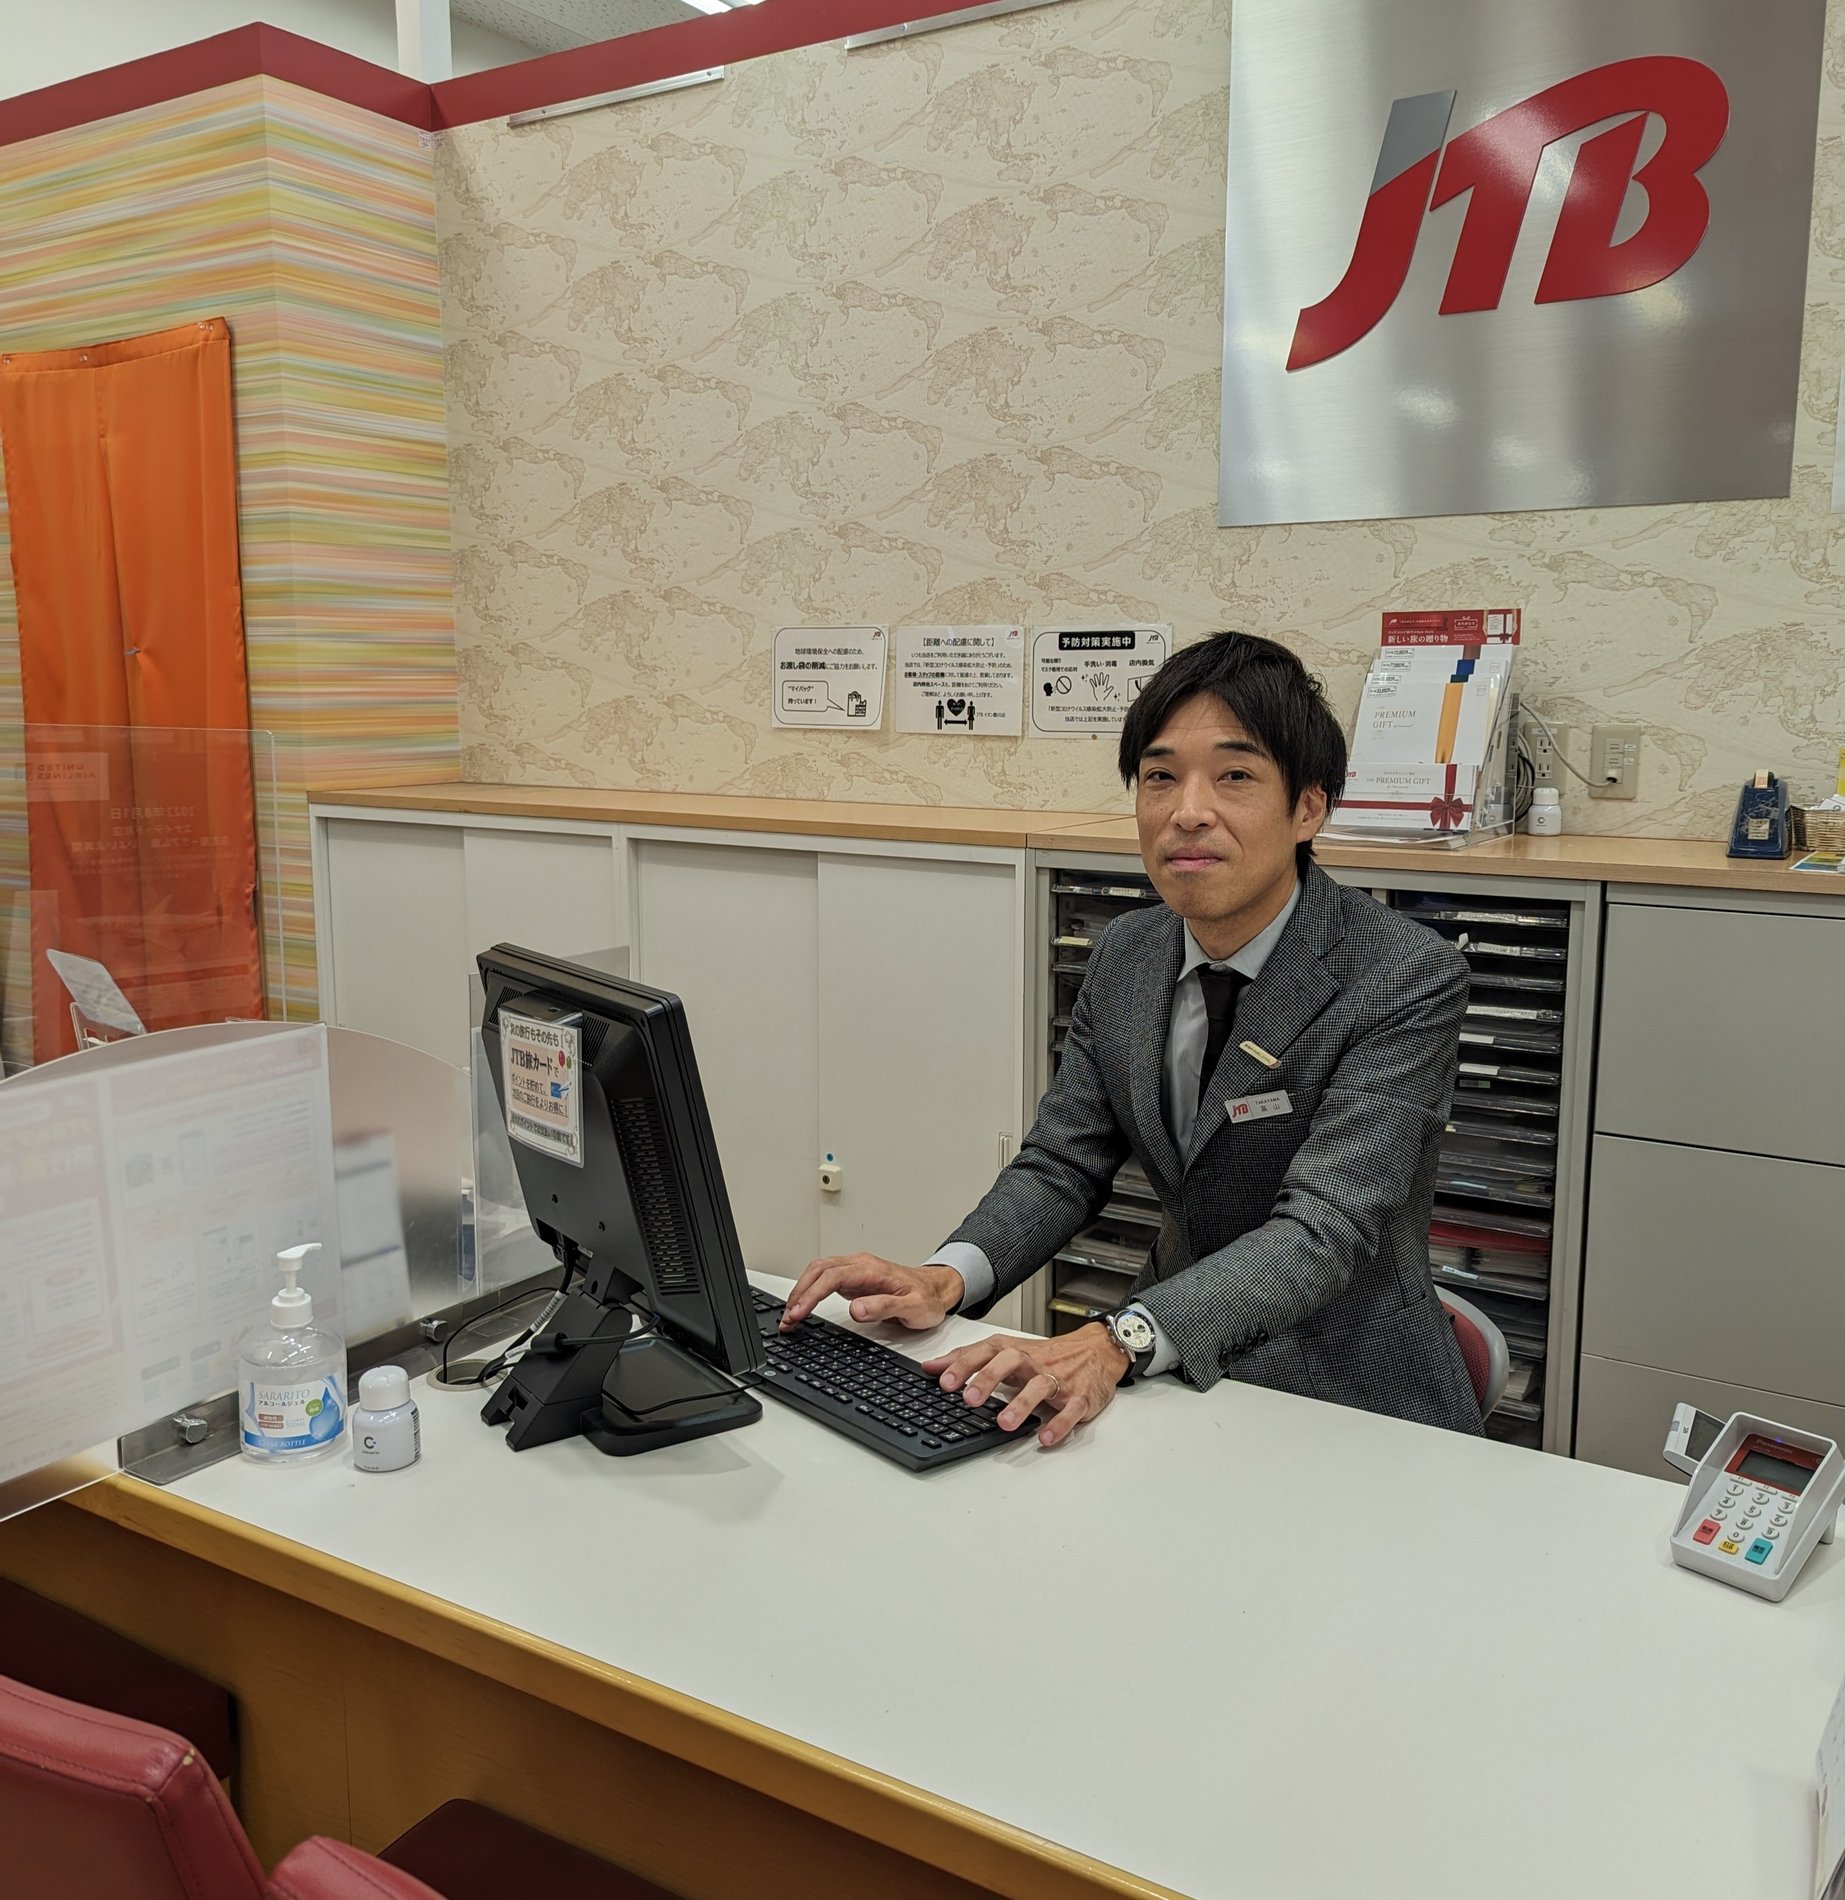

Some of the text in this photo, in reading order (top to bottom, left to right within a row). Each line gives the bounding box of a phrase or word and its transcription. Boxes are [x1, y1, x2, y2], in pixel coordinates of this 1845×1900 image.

[1286, 55, 1730, 372] JTB
[922, 637, 995, 647] 【距離への配慮に関して】
[1061, 637, 1132, 648] 予防対策実施中
[1387, 634, 1449, 645] 新しい旅の贈り物
[794, 647, 864, 656] 地球環境保全への配慮のため、
[780, 661, 878, 671] お渡し袋の削減にご協力をお願いします。
[1128, 659, 1155, 667] 店内換気
[1374, 710, 1416, 719] PREMIUM
[1373, 720, 1393, 729] GIFT
[1376, 777, 1411, 785] PREMIUM
[510, 1048, 559, 1078] JTB旅カードで
[1232, 1103, 1249, 1118] JTB
[258, 1389, 311, 1400] SARARITO
[258, 1399, 306, 1408] アルコールジェル
[280, 1439, 306, 1447] BOTTLE
